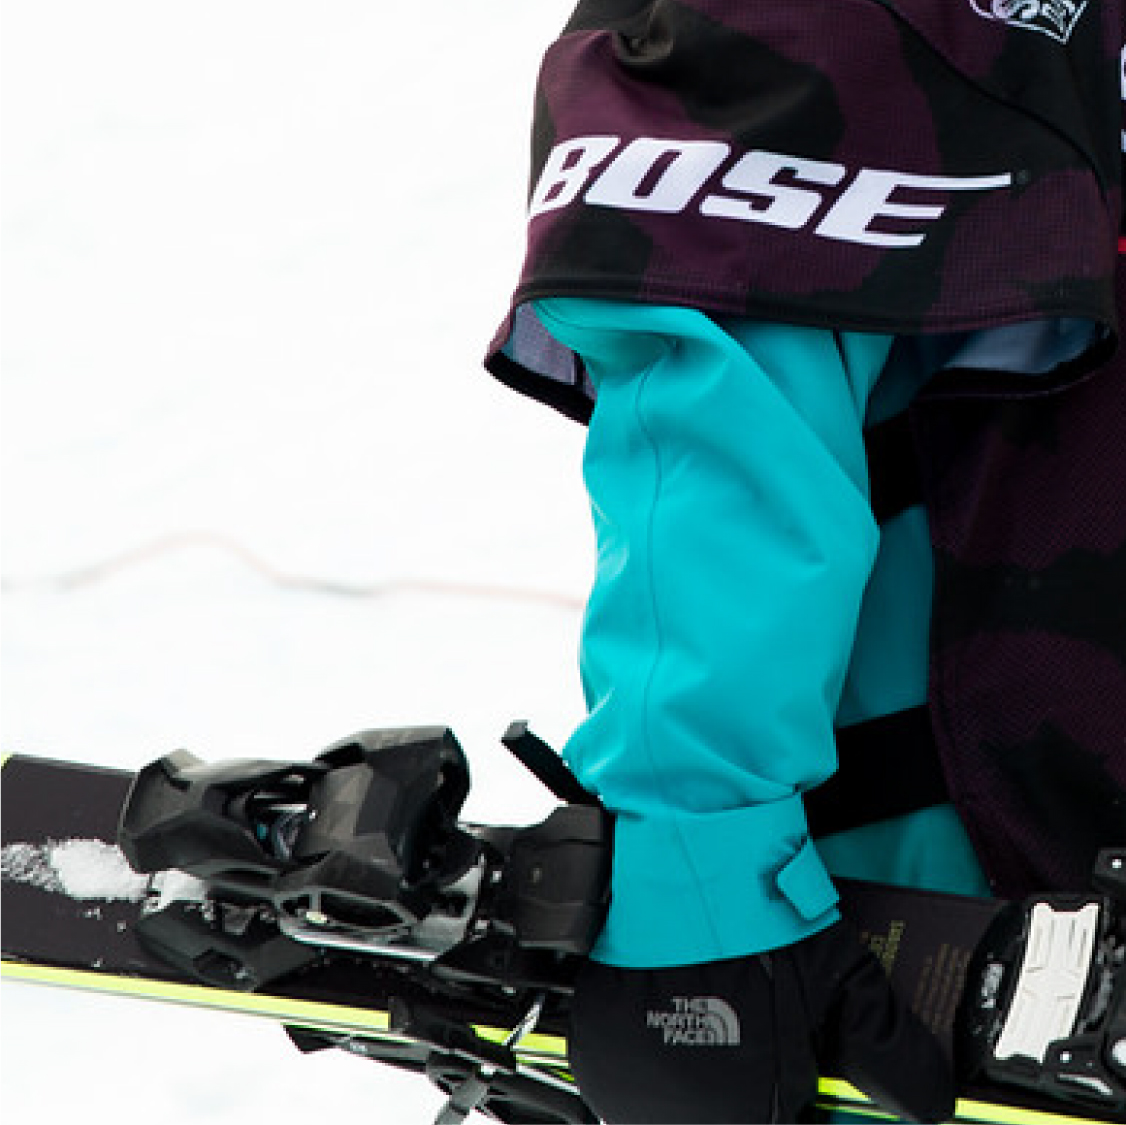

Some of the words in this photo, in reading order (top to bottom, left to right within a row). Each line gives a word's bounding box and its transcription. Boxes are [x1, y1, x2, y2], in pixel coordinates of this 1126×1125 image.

[528, 135, 1012, 247] BOSE
[670, 996, 708, 1012] THE
[646, 1010, 703, 1028] NORTH
[663, 1028, 710, 1045] FACE
